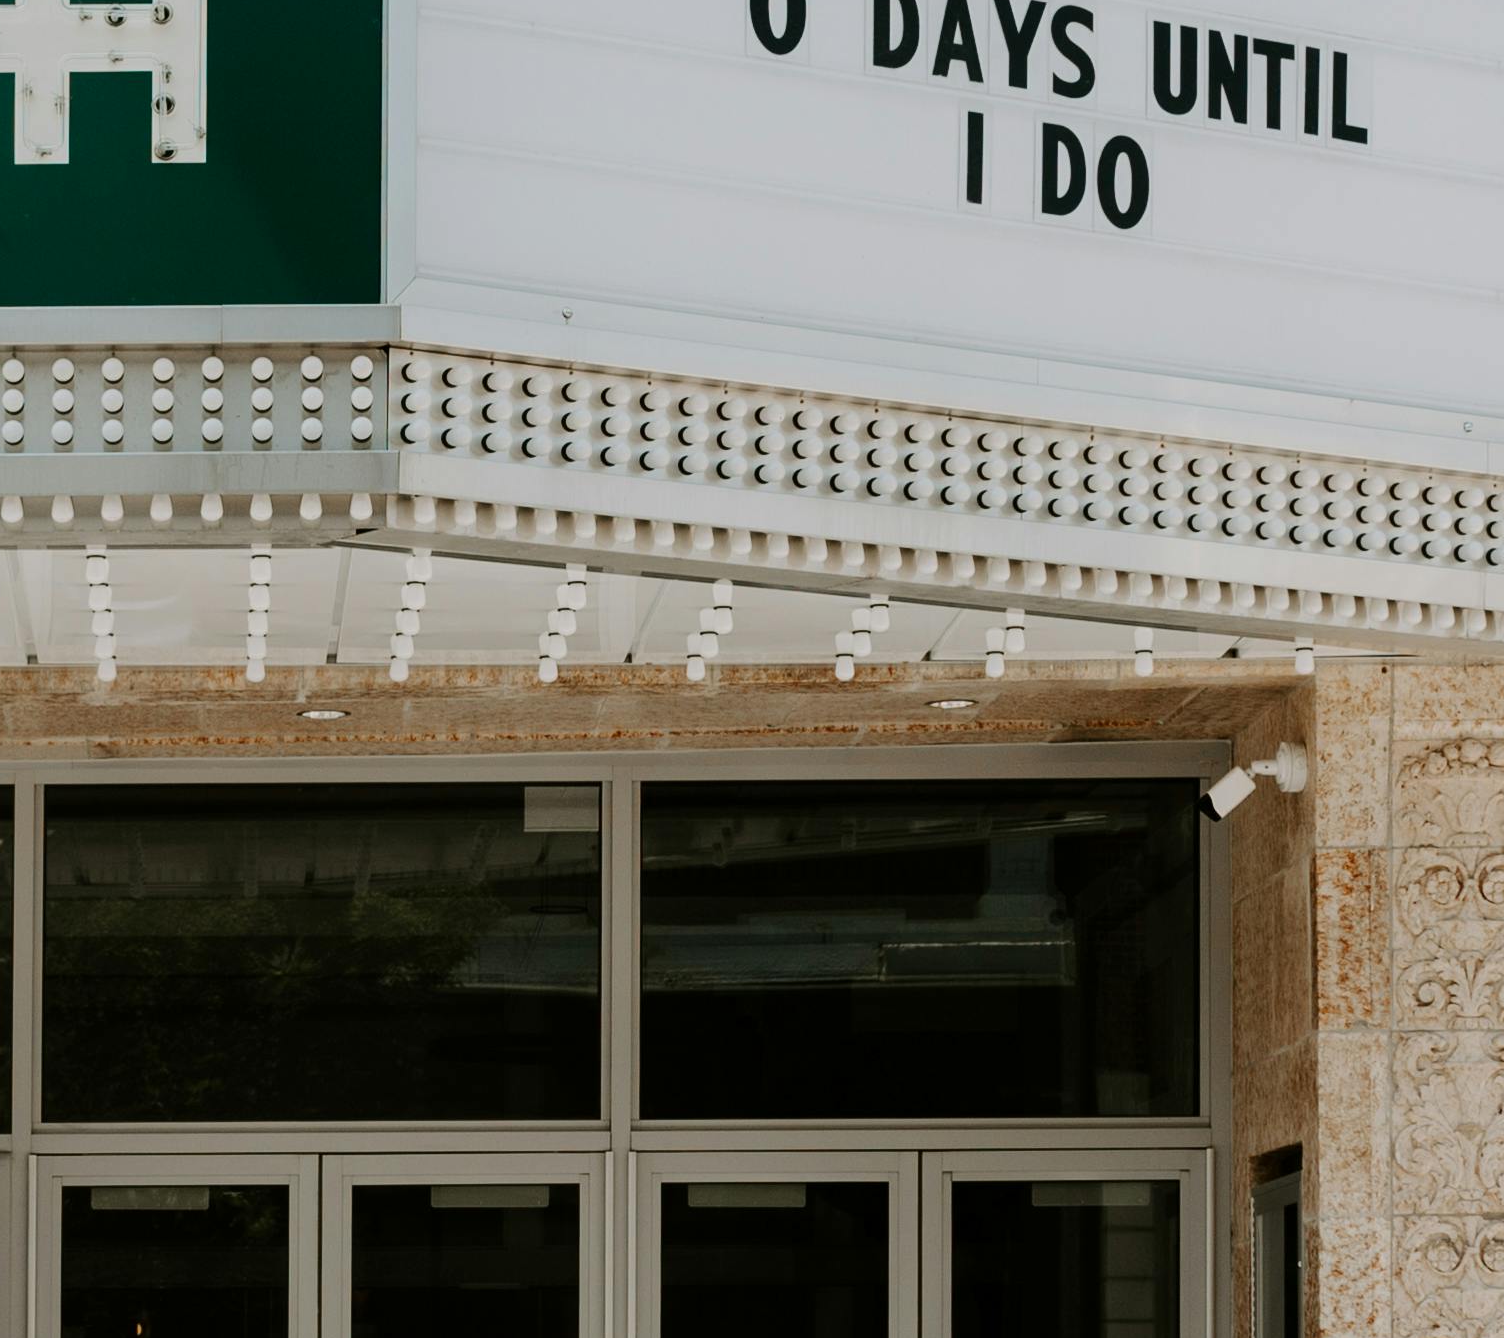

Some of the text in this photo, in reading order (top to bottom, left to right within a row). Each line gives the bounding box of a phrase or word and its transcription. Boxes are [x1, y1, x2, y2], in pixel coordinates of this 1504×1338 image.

[1153, 20, 1368, 145] UNTIL
[966, 110, 1150, 230] I DO
